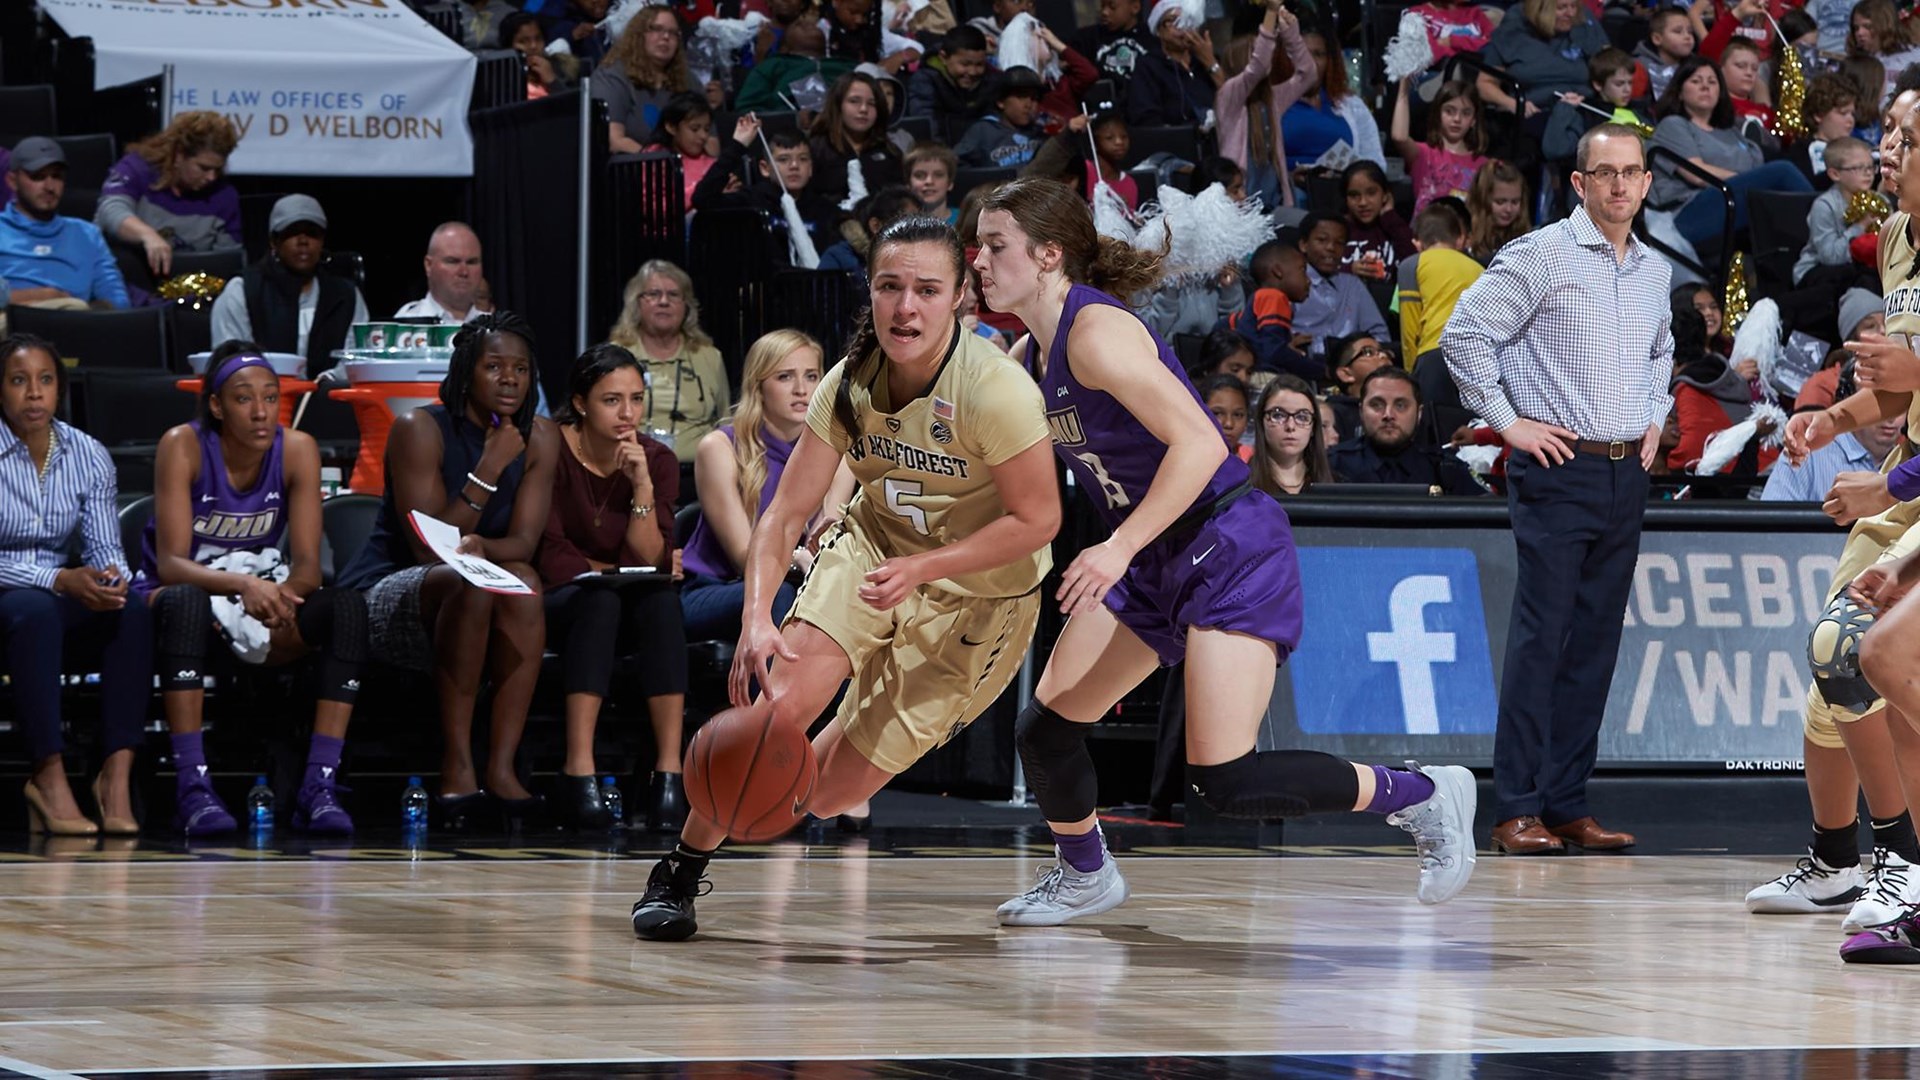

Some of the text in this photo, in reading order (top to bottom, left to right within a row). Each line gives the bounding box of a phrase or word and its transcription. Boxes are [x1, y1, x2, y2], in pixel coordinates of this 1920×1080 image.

[172, 88, 406, 111] HE LAW OFFICES OF
[269, 113, 289, 137] D
[303, 114, 443, 140] WELBORN
[848, 434, 968, 479] WAKE FOREST
[884, 477, 931, 536] 5
[191, 508, 277, 540] JMU
[1624, 553, 1838, 627] CEBO
[1725, 760, 1806, 770] DAKTRONIC
